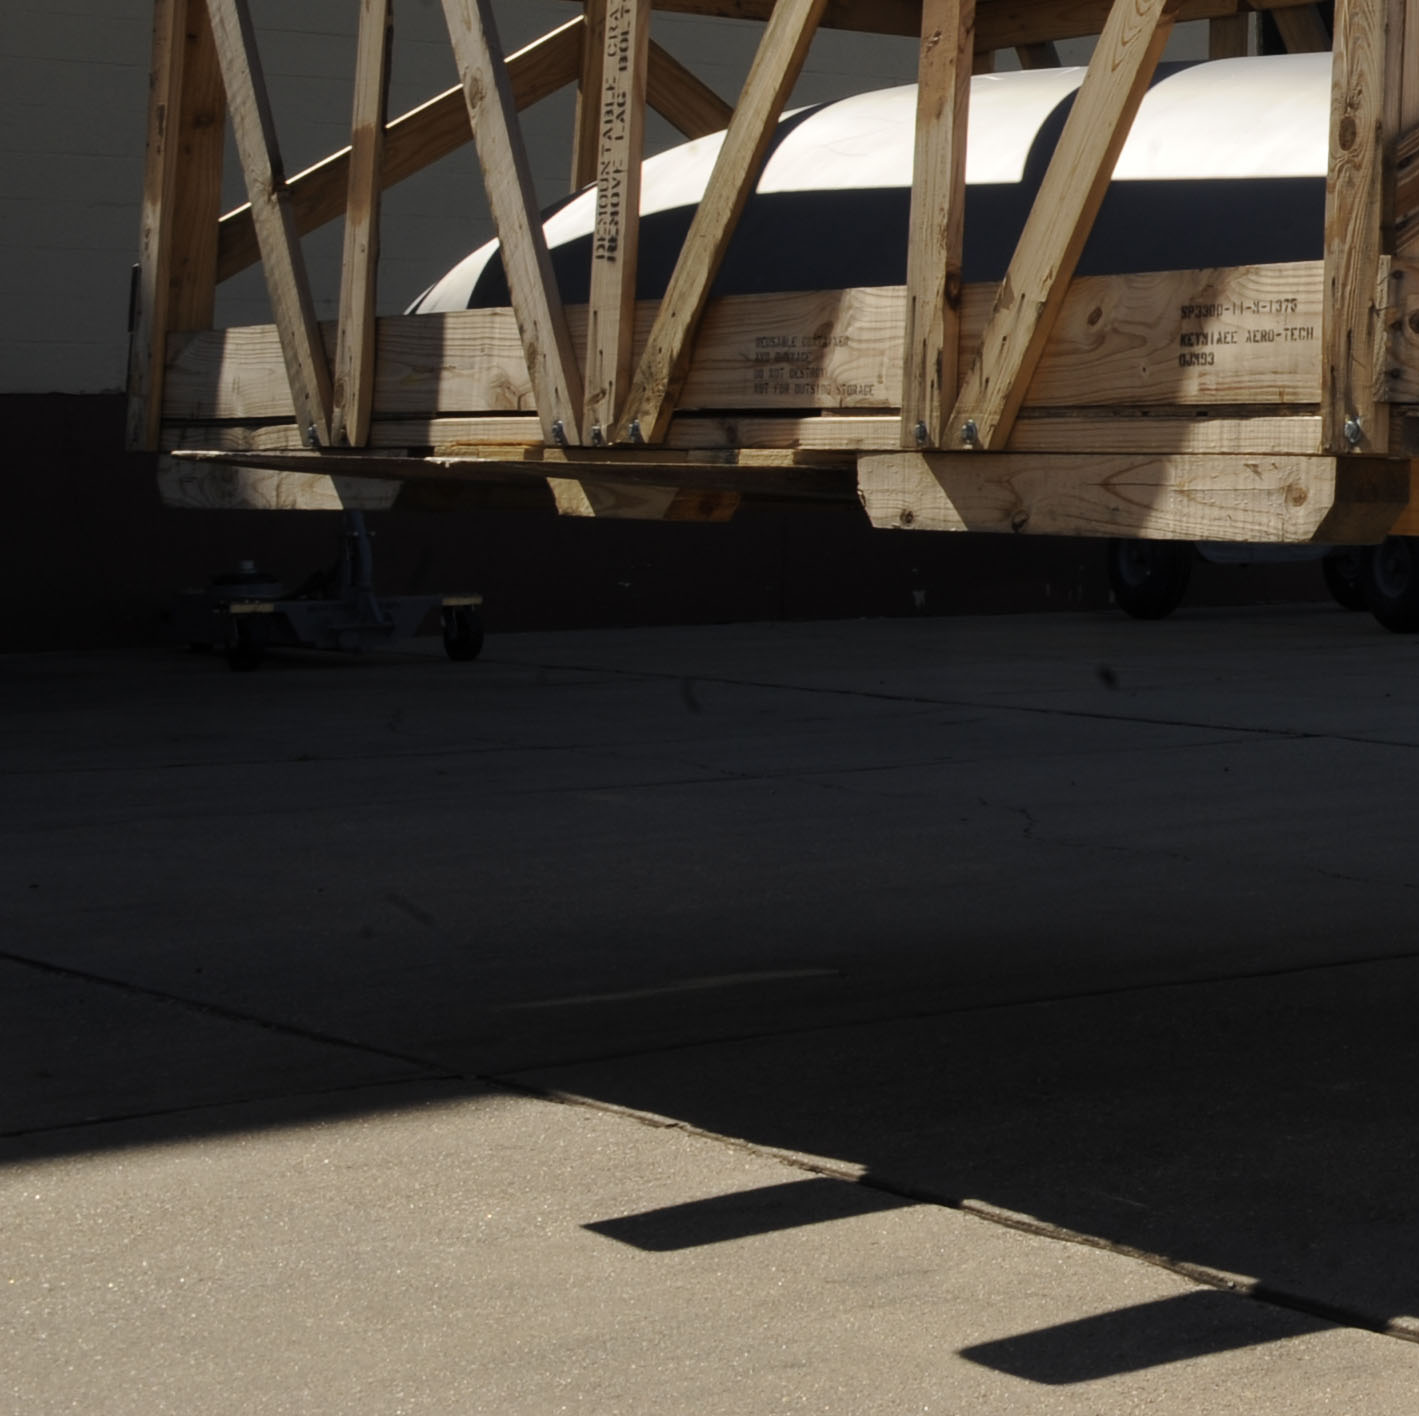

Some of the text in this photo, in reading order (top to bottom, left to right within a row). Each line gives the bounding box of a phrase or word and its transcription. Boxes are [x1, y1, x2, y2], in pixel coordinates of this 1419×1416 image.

[614, 90, 627, 141] LAG
[594, 76, 617, 261] DEMOUNTABLE
[605, 159, 627, 264] REMOVE
[1246, 326, 1315, 345] AERO-TECH
